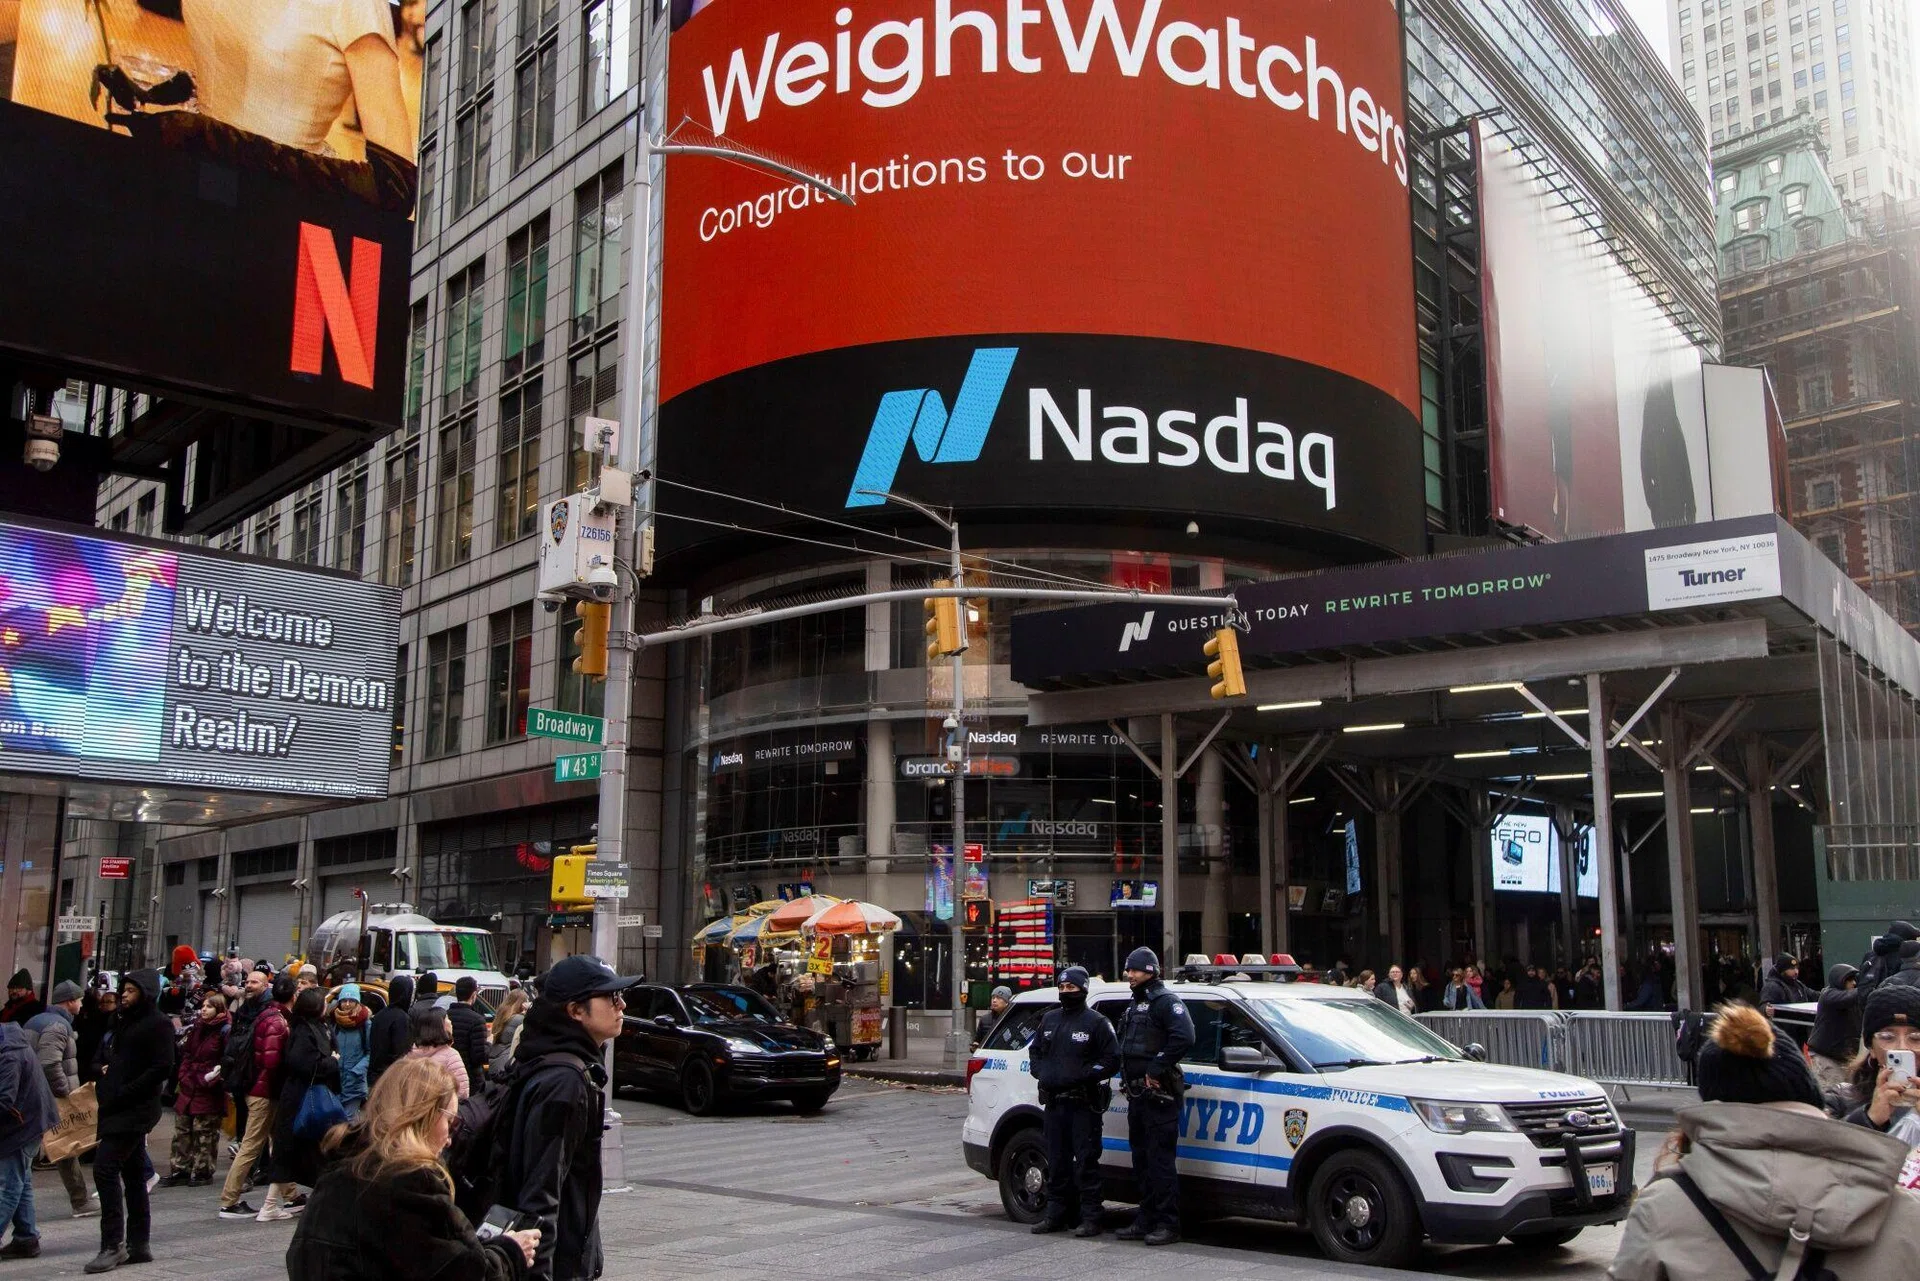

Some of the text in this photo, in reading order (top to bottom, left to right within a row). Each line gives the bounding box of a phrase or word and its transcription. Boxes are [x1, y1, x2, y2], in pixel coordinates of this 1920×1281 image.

[702, 0, 1408, 188] WeightWatchers
[699, 149, 1131, 242] Congratulations to our
[291, 222, 382, 389] N
[1029, 387, 1336, 510] Nasdaq
[582, 526, 611, 542] 726156
[1666, 552, 1701, 560] Broadway
[1753, 540, 1775, 549] 10036
[1678, 567, 1746, 587] Turner
[185, 586, 333, 647] Welcome
[1256, 604, 1309, 621] TODAY
[1326, 591, 1412, 613] REWRITE
[179, 649, 387, 709] to the Demon
[172, 703, 297, 754] Realm!
[536, 712, 594, 742] Broadway
[968, 731, 1017, 746] Nasdaq
[1041, 733, 1096, 744] REWRITE
[720, 752, 743, 766] Nasdaq
[755, 740, 853, 760] REWRITE TOMORROW
[561, 755, 597, 778] W 43 St
[1032, 819, 1098, 839] Nasdaq
[1332, 1088, 1377, 1106] POLICE
[1178, 1097, 1264, 1146] NYPD
